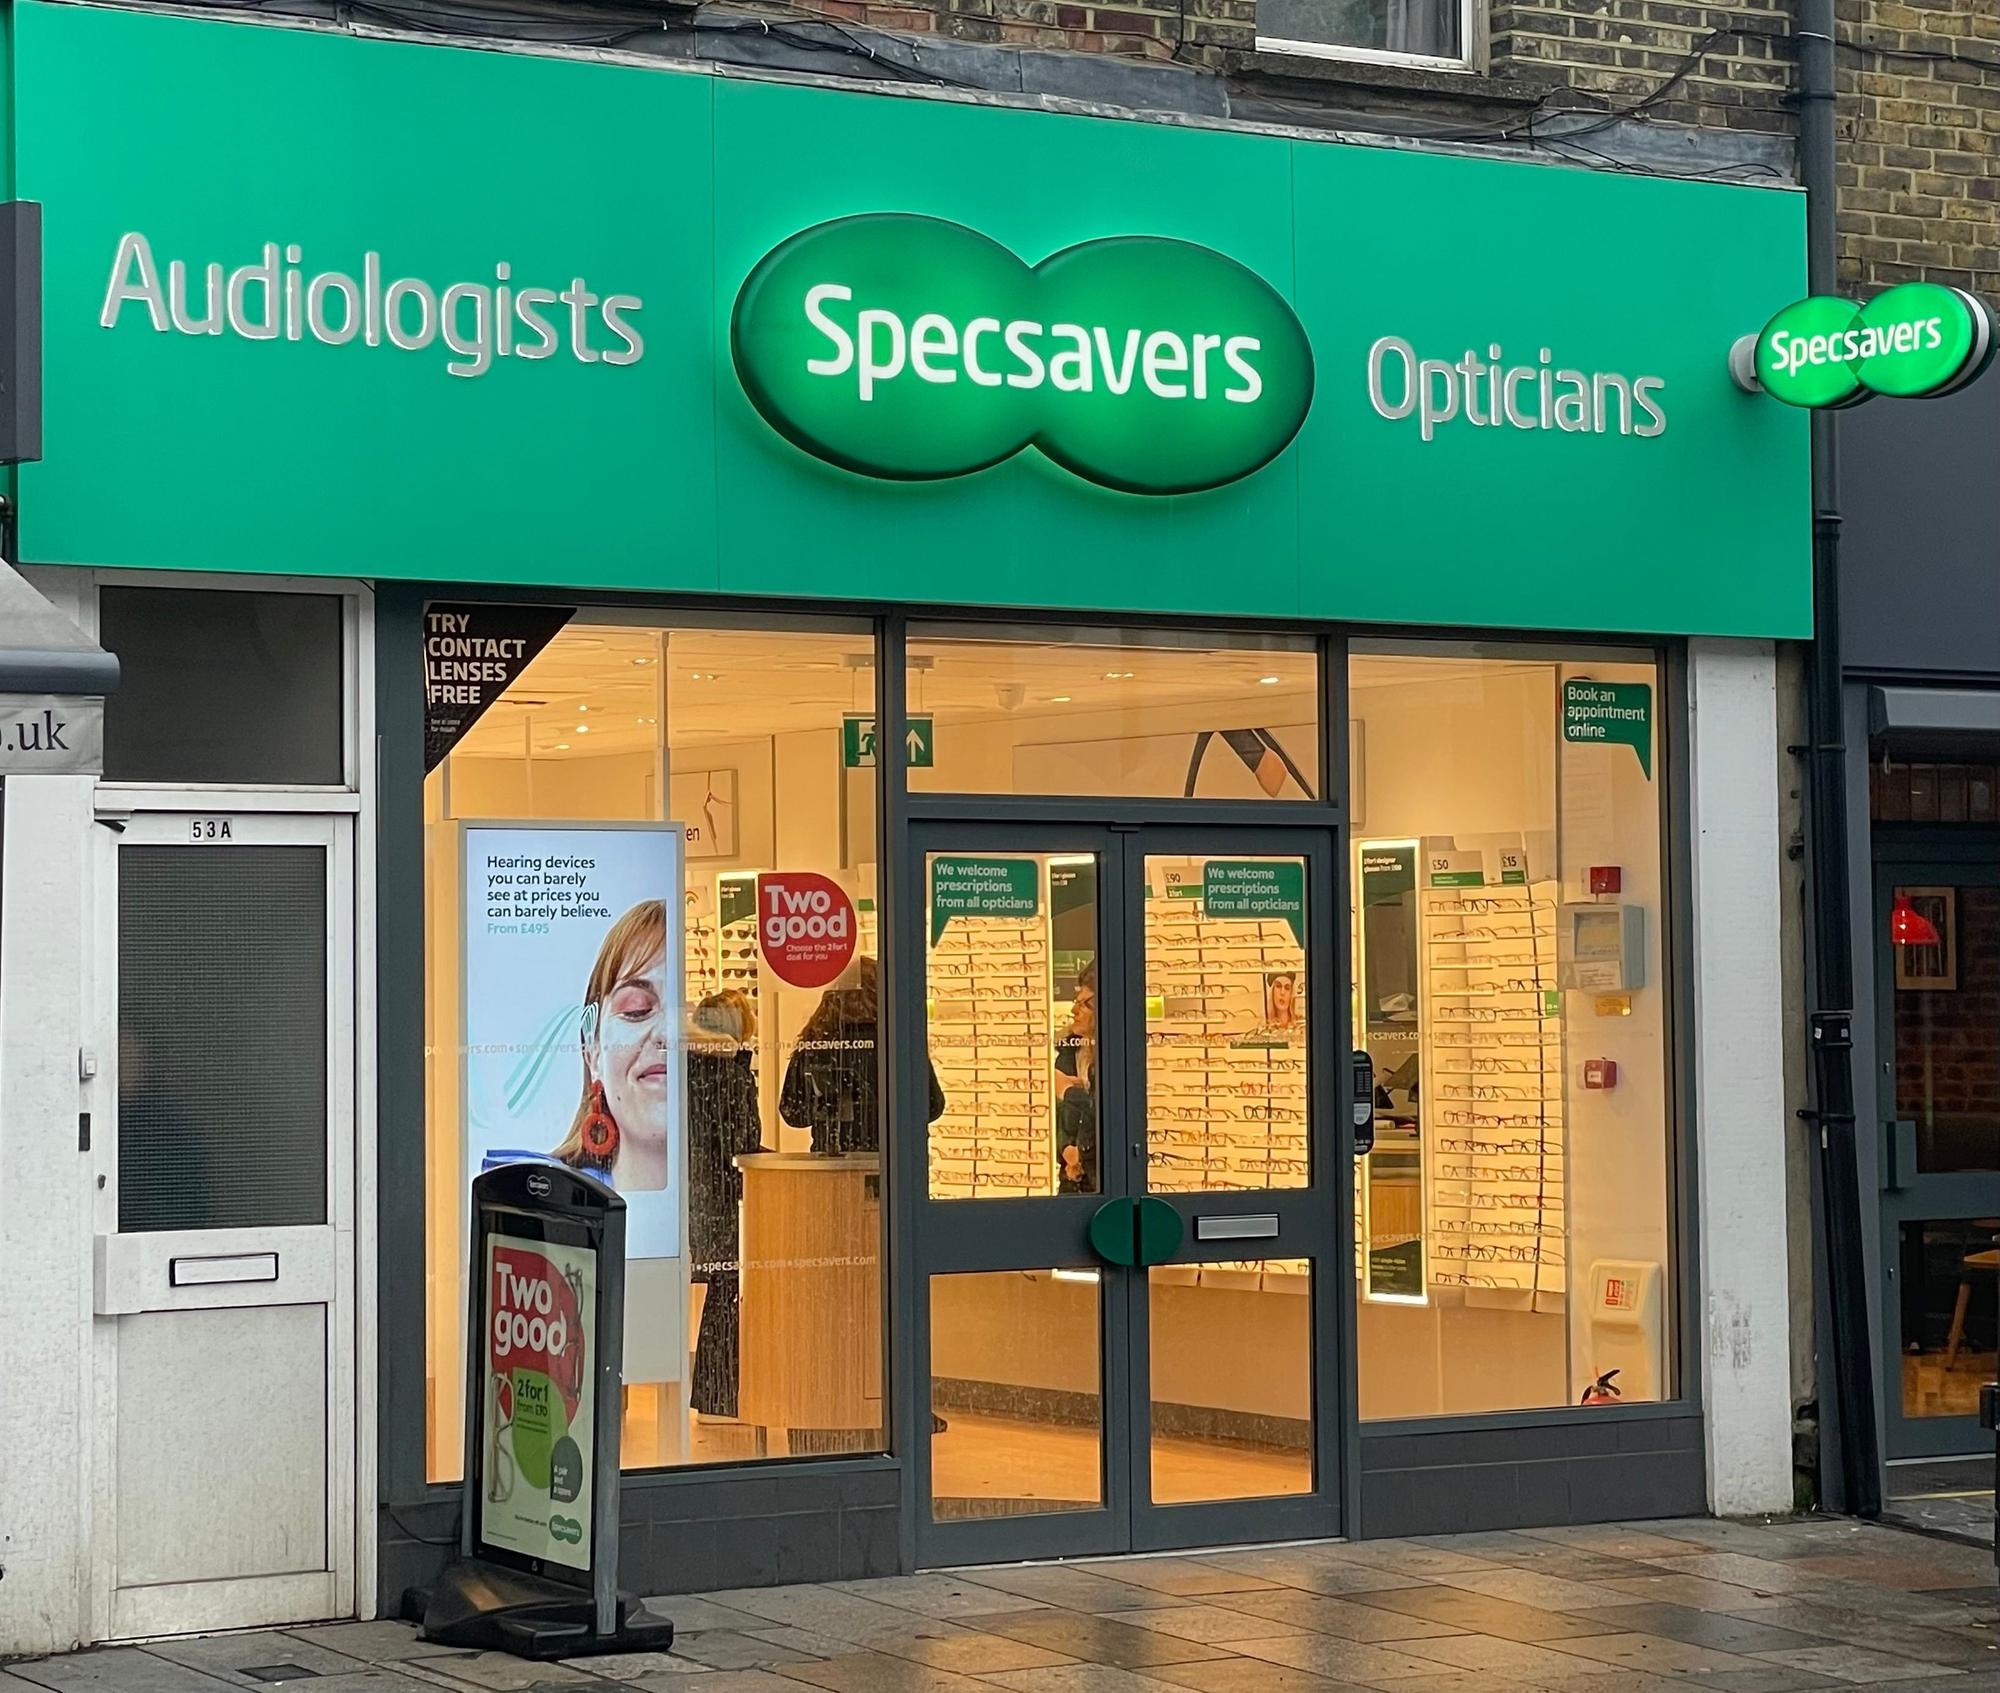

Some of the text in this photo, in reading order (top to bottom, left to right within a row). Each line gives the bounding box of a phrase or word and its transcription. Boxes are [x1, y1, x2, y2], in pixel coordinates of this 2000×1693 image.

[99, 231, 645, 378] Audiologists
[803, 282, 1263, 403] Specsavers
[1770, 316, 1942, 377] Specsavers
[1368, 335, 1667, 442] Opticians
[428, 613, 470, 633] TRY
[428, 637, 526, 658] CONTACT
[429, 661, 507, 682] LENSES
[430, 684, 481, 704] FREE
[1567, 686, 1616, 702] Book an
[1567, 704, 1646, 721] appointment
[0, 710, 70, 751] .uk
[1568, 722, 1606, 738] online
[192, 821, 232, 838] 53A
[487, 855, 595, 871] Hearing devices
[936, 863, 1008, 877] We welcome
[1432, 859, 1449, 871] £50
[487, 872, 586, 888] you can barely
[1207, 867, 1275, 879] We welcome
[936, 879, 1012, 894] prescriptions
[1207, 882, 1280, 896] prescriptions
[487, 888, 600, 904] see at prices you
[765, 885, 831, 915] Two
[936, 895, 1034, 911] from all opticians
[487, 904, 611, 920] can barely believe.
[1208, 898, 1300, 912] from all opticians
[487, 923, 549, 934] From £495
[766, 907, 847, 948] good
[496, 1261, 553, 1315] Two
[495, 1308, 567, 1357] good
